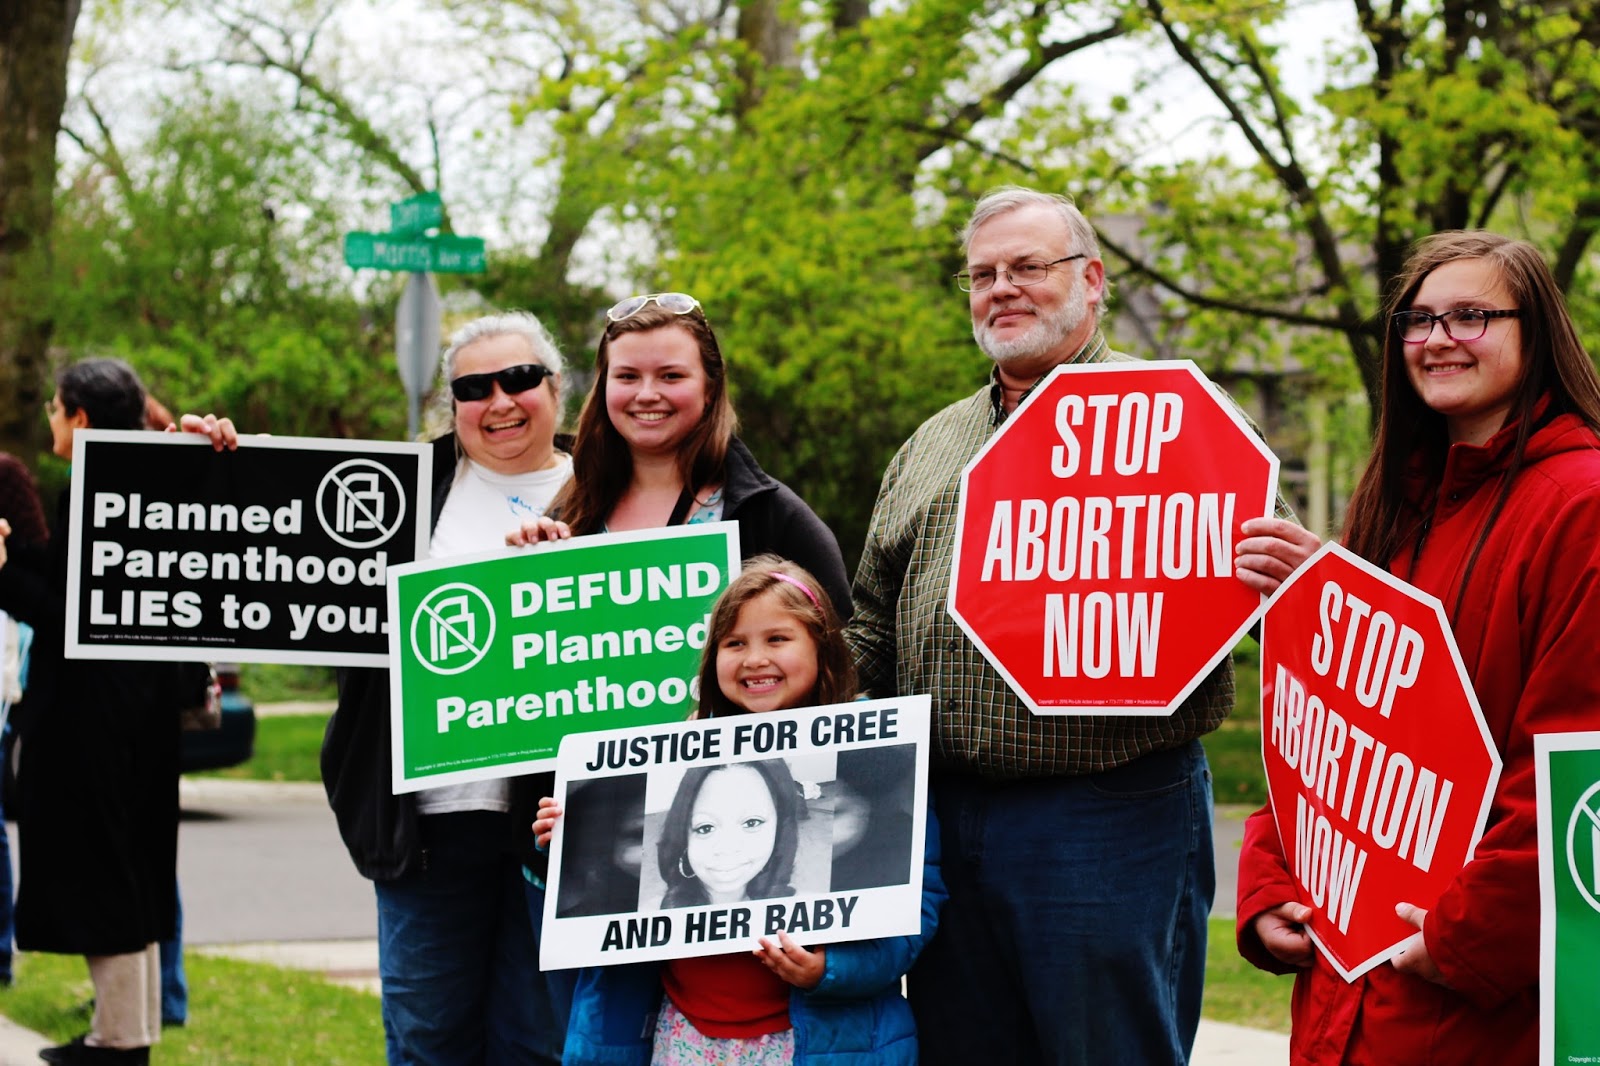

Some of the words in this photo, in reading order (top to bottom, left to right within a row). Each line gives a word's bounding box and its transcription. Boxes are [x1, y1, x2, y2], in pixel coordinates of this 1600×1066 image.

[1051, 392, 1183, 478] STOP
[94, 492, 302, 534] Planned
[981, 492, 1236, 581] ABORTION
[92, 541, 387, 586] Parenthood
[511, 562, 720, 618] DEFUND
[90, 590, 202, 628] LIES
[221, 594, 271, 630] to
[1043, 592, 1163, 678] NOW
[513, 613, 711, 669] Planned
[1312, 580, 1424, 718] STOP
[586, 728, 722, 772] JUSTICE
[733, 720, 798, 756] FOR
[811, 708, 898, 747] CREE
[1272, 663, 1453, 872] ABORTION
[1296, 793, 1367, 936] NOW
[600, 915, 672, 952] AND
[685, 907, 751, 944] HER
[764, 896, 859, 936] BABY
[1568, 1055, 1591, 1064] Copyright
